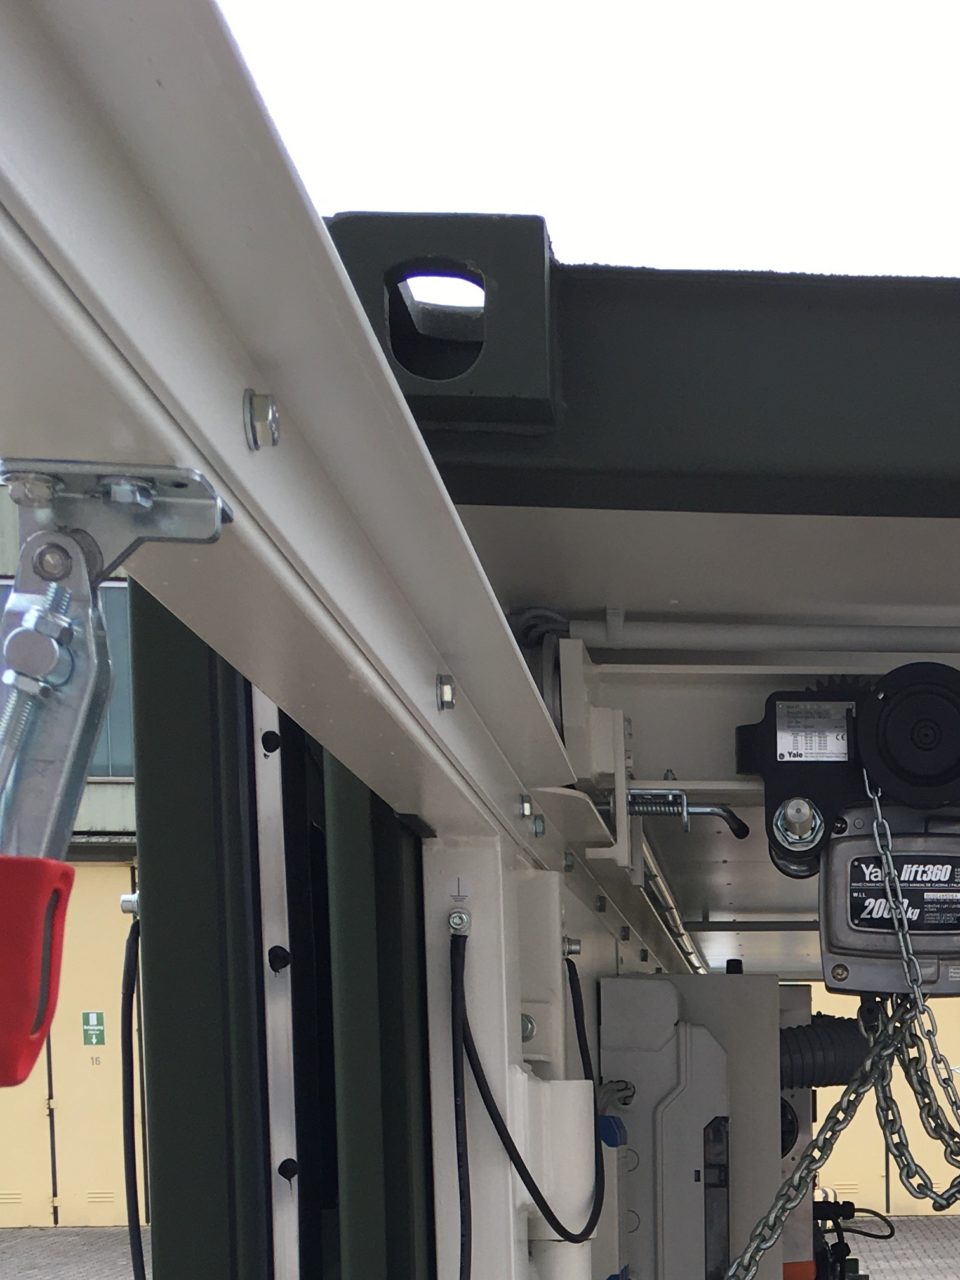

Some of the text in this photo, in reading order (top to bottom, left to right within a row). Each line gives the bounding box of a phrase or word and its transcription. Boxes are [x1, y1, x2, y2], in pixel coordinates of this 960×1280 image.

[787, 751, 803, 759] Yale
[900, 864, 952, 882] lift360
[906, 907, 921, 921] kg
